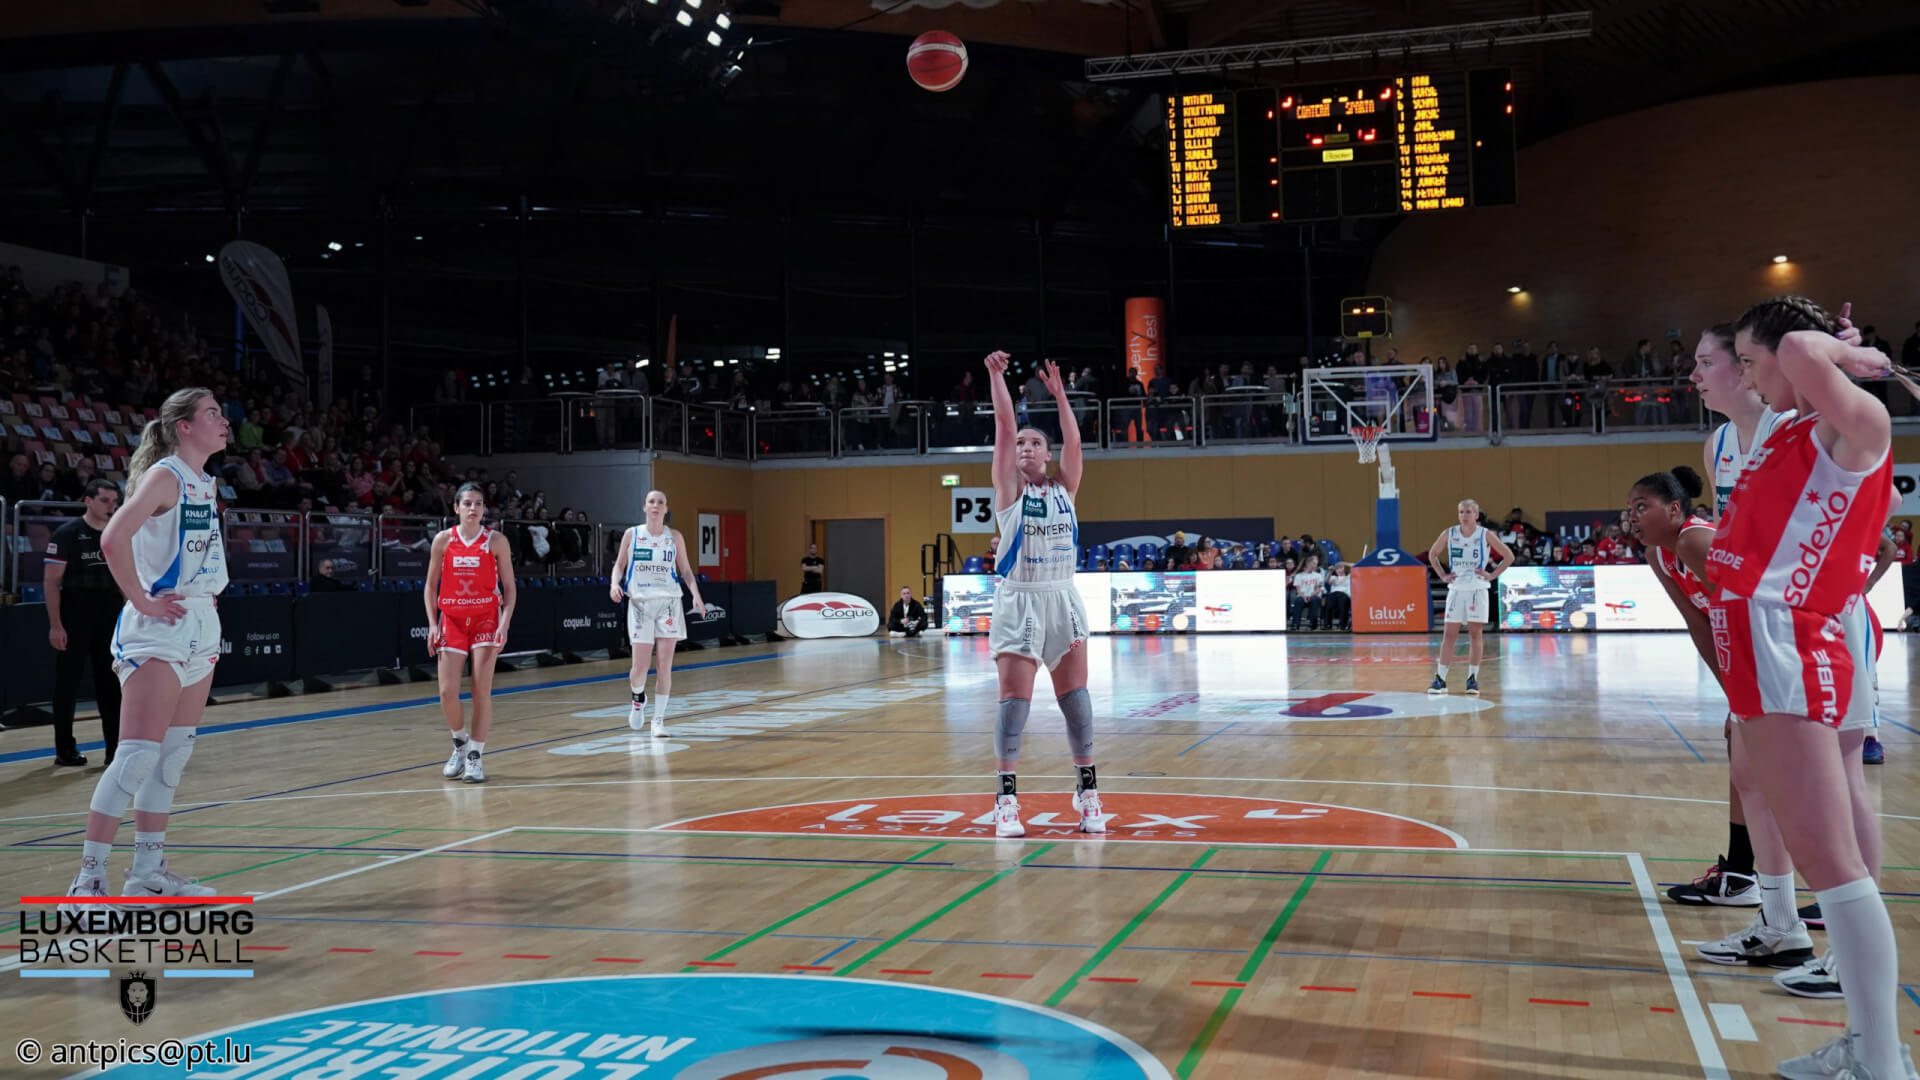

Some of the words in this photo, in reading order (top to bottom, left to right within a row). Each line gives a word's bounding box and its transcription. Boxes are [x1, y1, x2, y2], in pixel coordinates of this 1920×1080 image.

[955, 498, 991, 524] P3
[1023, 523, 1072, 536] CONTERN
[702, 526, 716, 554] P1
[480, 542, 489, 553] 4
[1473, 549, 1479, 558] 6
[1784, 491, 1849, 607] sodexo
[663, 551, 672, 562] 10
[821, 608, 874, 619] Coque
[1369, 606, 1406, 620] lalux
[563, 616, 591, 630] coque.lu
[278, 1019, 696, 1061] NATIONALE
